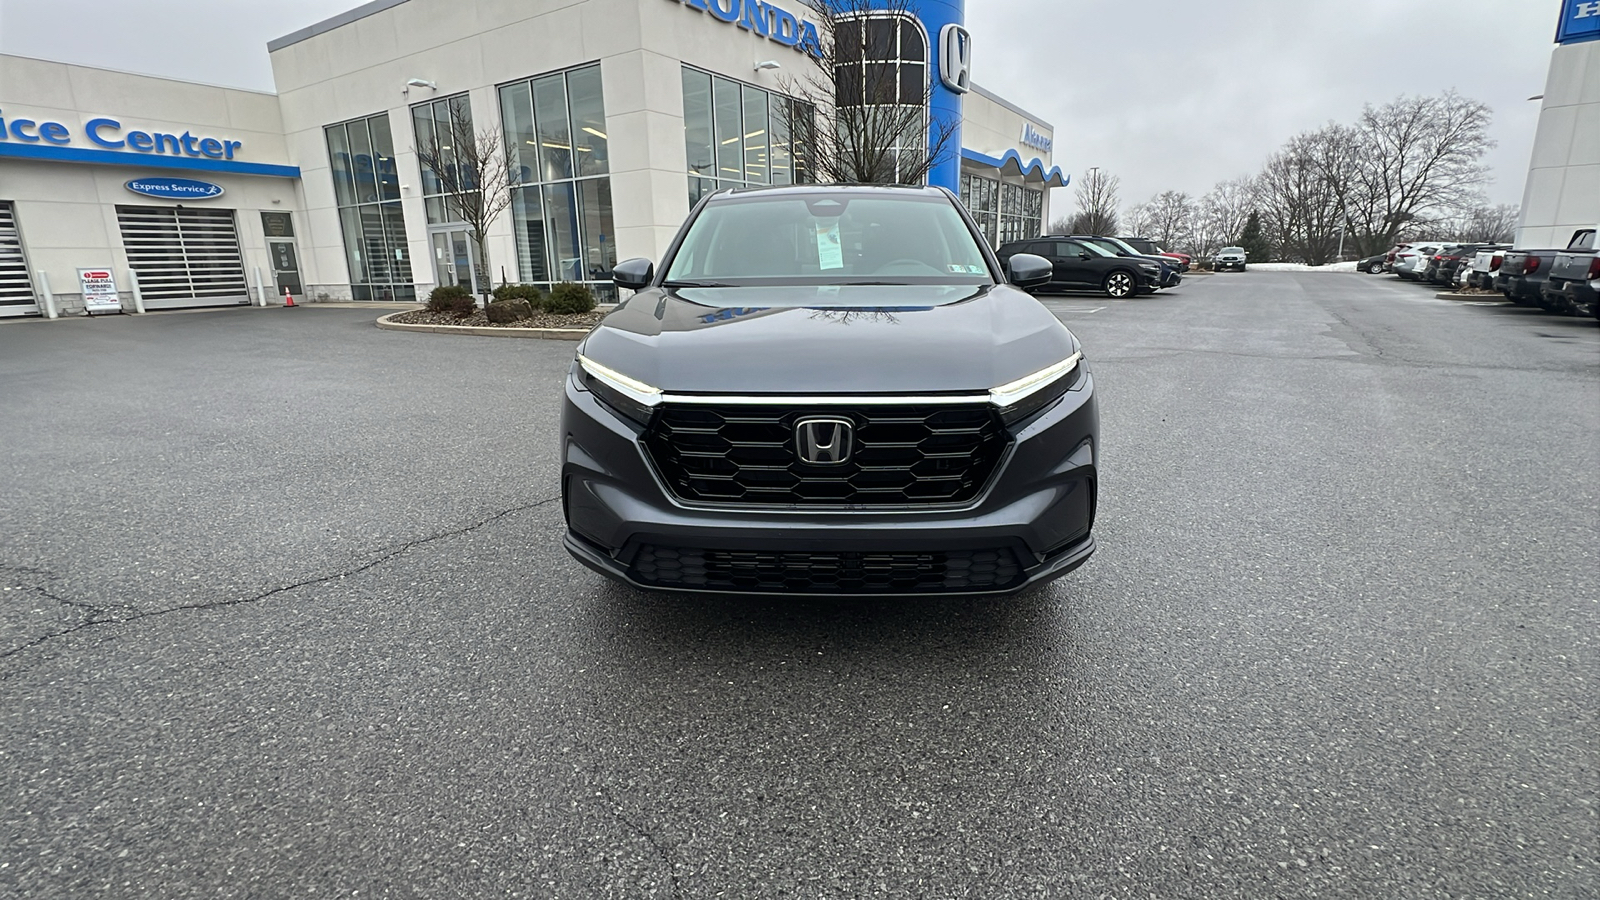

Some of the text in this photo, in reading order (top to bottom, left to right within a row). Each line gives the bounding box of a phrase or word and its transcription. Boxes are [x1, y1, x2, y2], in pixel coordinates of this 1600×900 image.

[672, 0, 823, 58] ONDA
[85, 118, 242, 159] Center
[132, 182, 205, 193] Express Service
